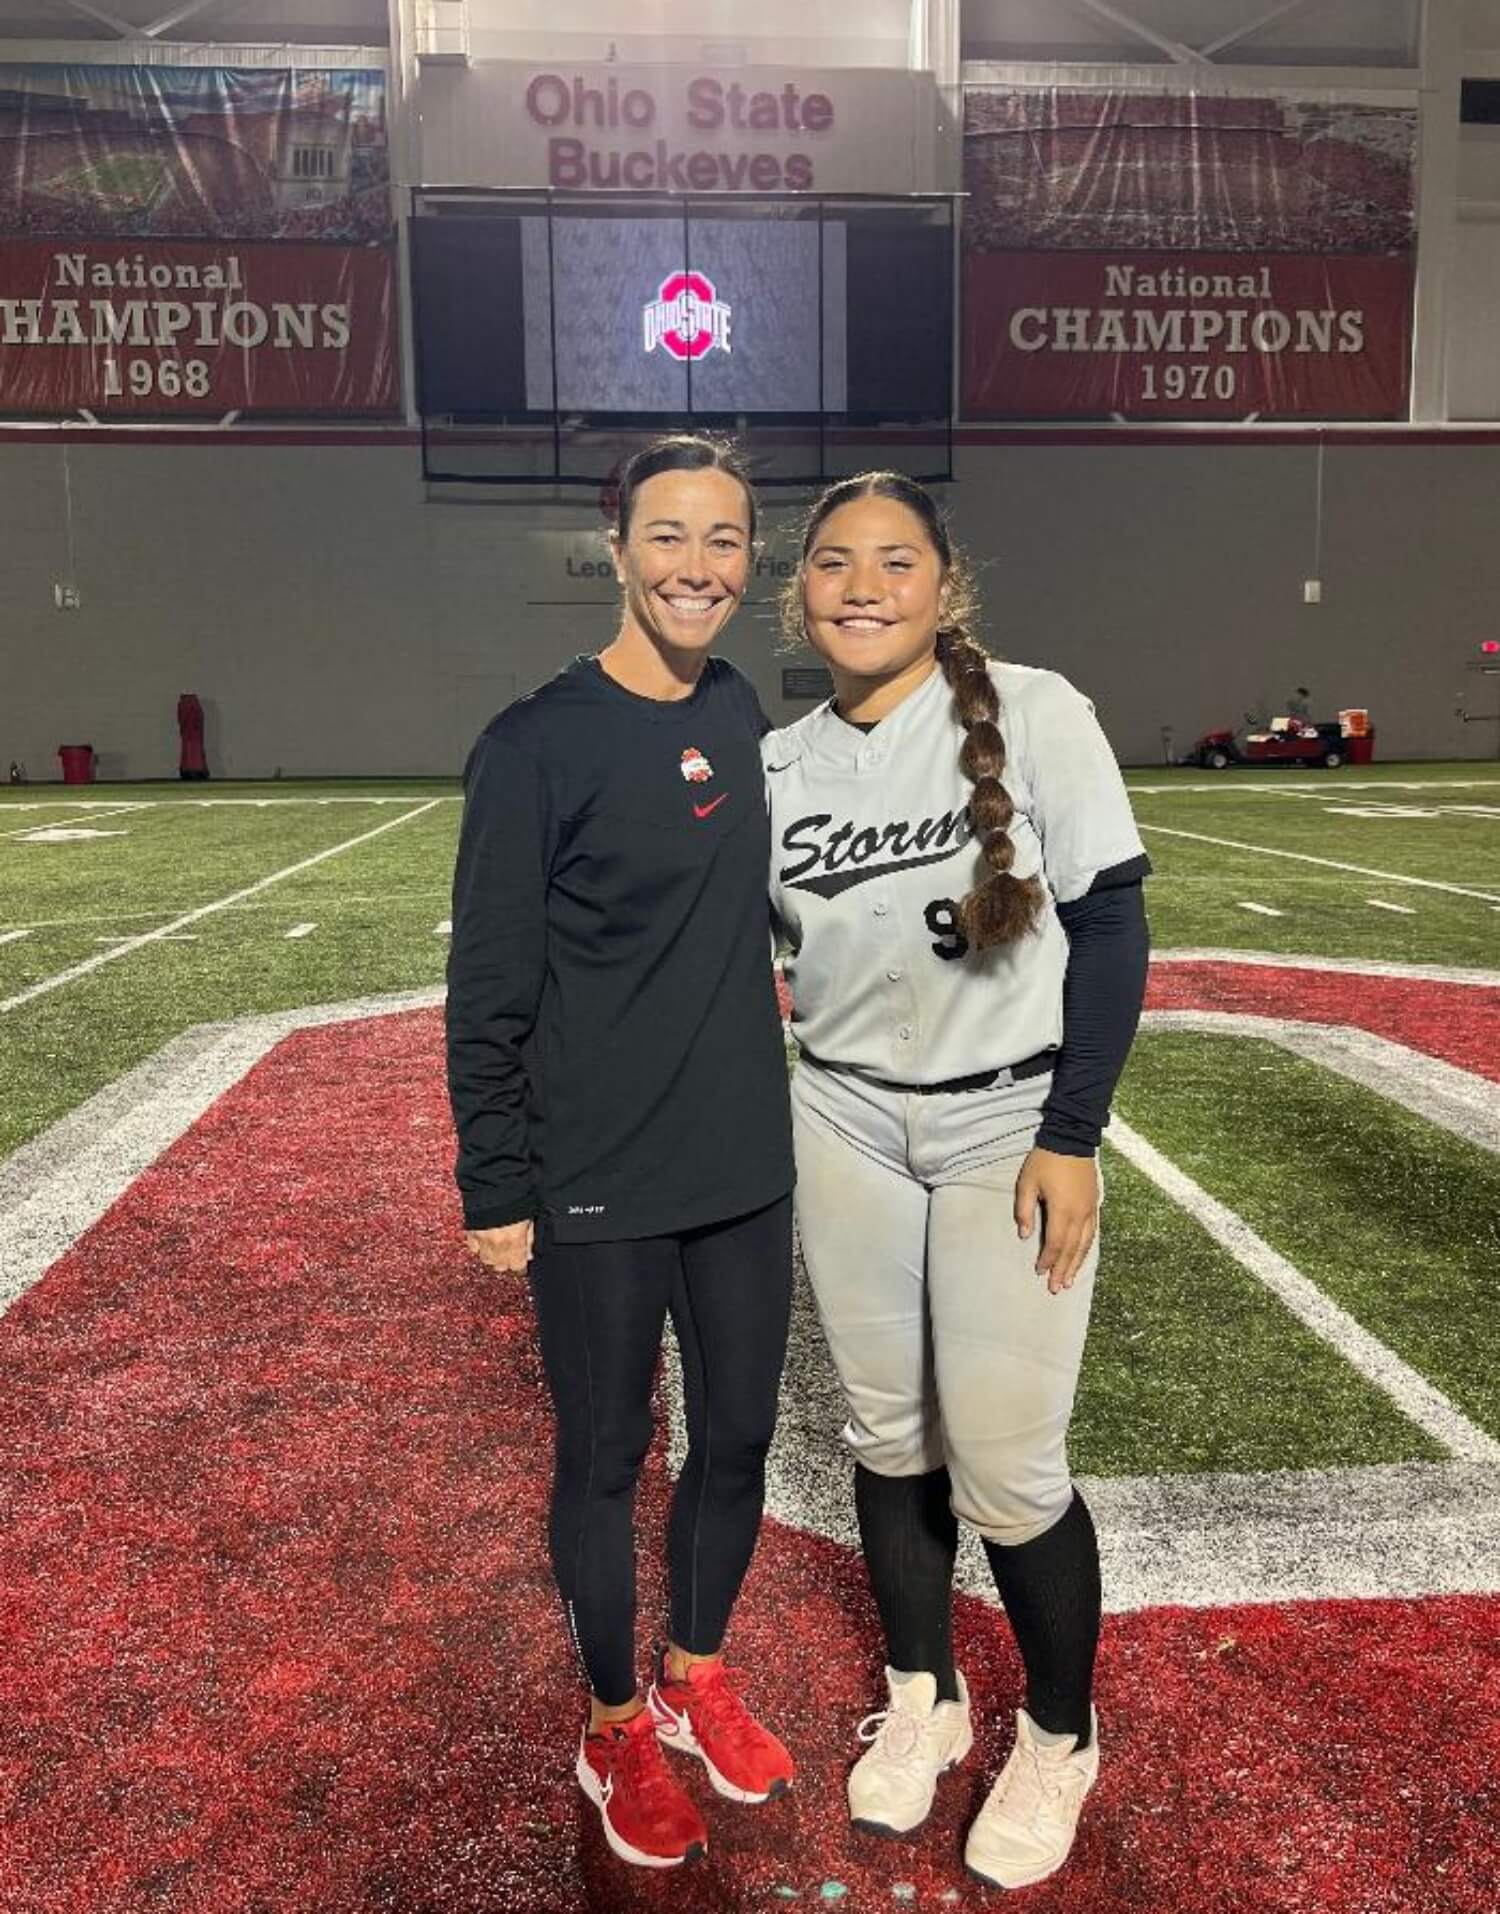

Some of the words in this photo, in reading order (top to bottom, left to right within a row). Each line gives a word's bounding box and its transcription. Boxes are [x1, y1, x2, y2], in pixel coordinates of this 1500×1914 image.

[526, 74, 655, 127] Ohio
[687, 78, 834, 130] State
[549, 137, 813, 190] Buckeyes
[53, 253, 242, 289] National
[1105, 265, 1272, 299] National
[0, 299, 351, 348] HAMPIONS
[1009, 308, 1364, 353] CHAMPIONS
[104, 359, 210, 397] 1968
[1141, 365, 1236, 400] 1970
[756, 556, 797, 577] Fie
[780, 804, 973, 884] Storm
[923, 898, 969, 960] 9
